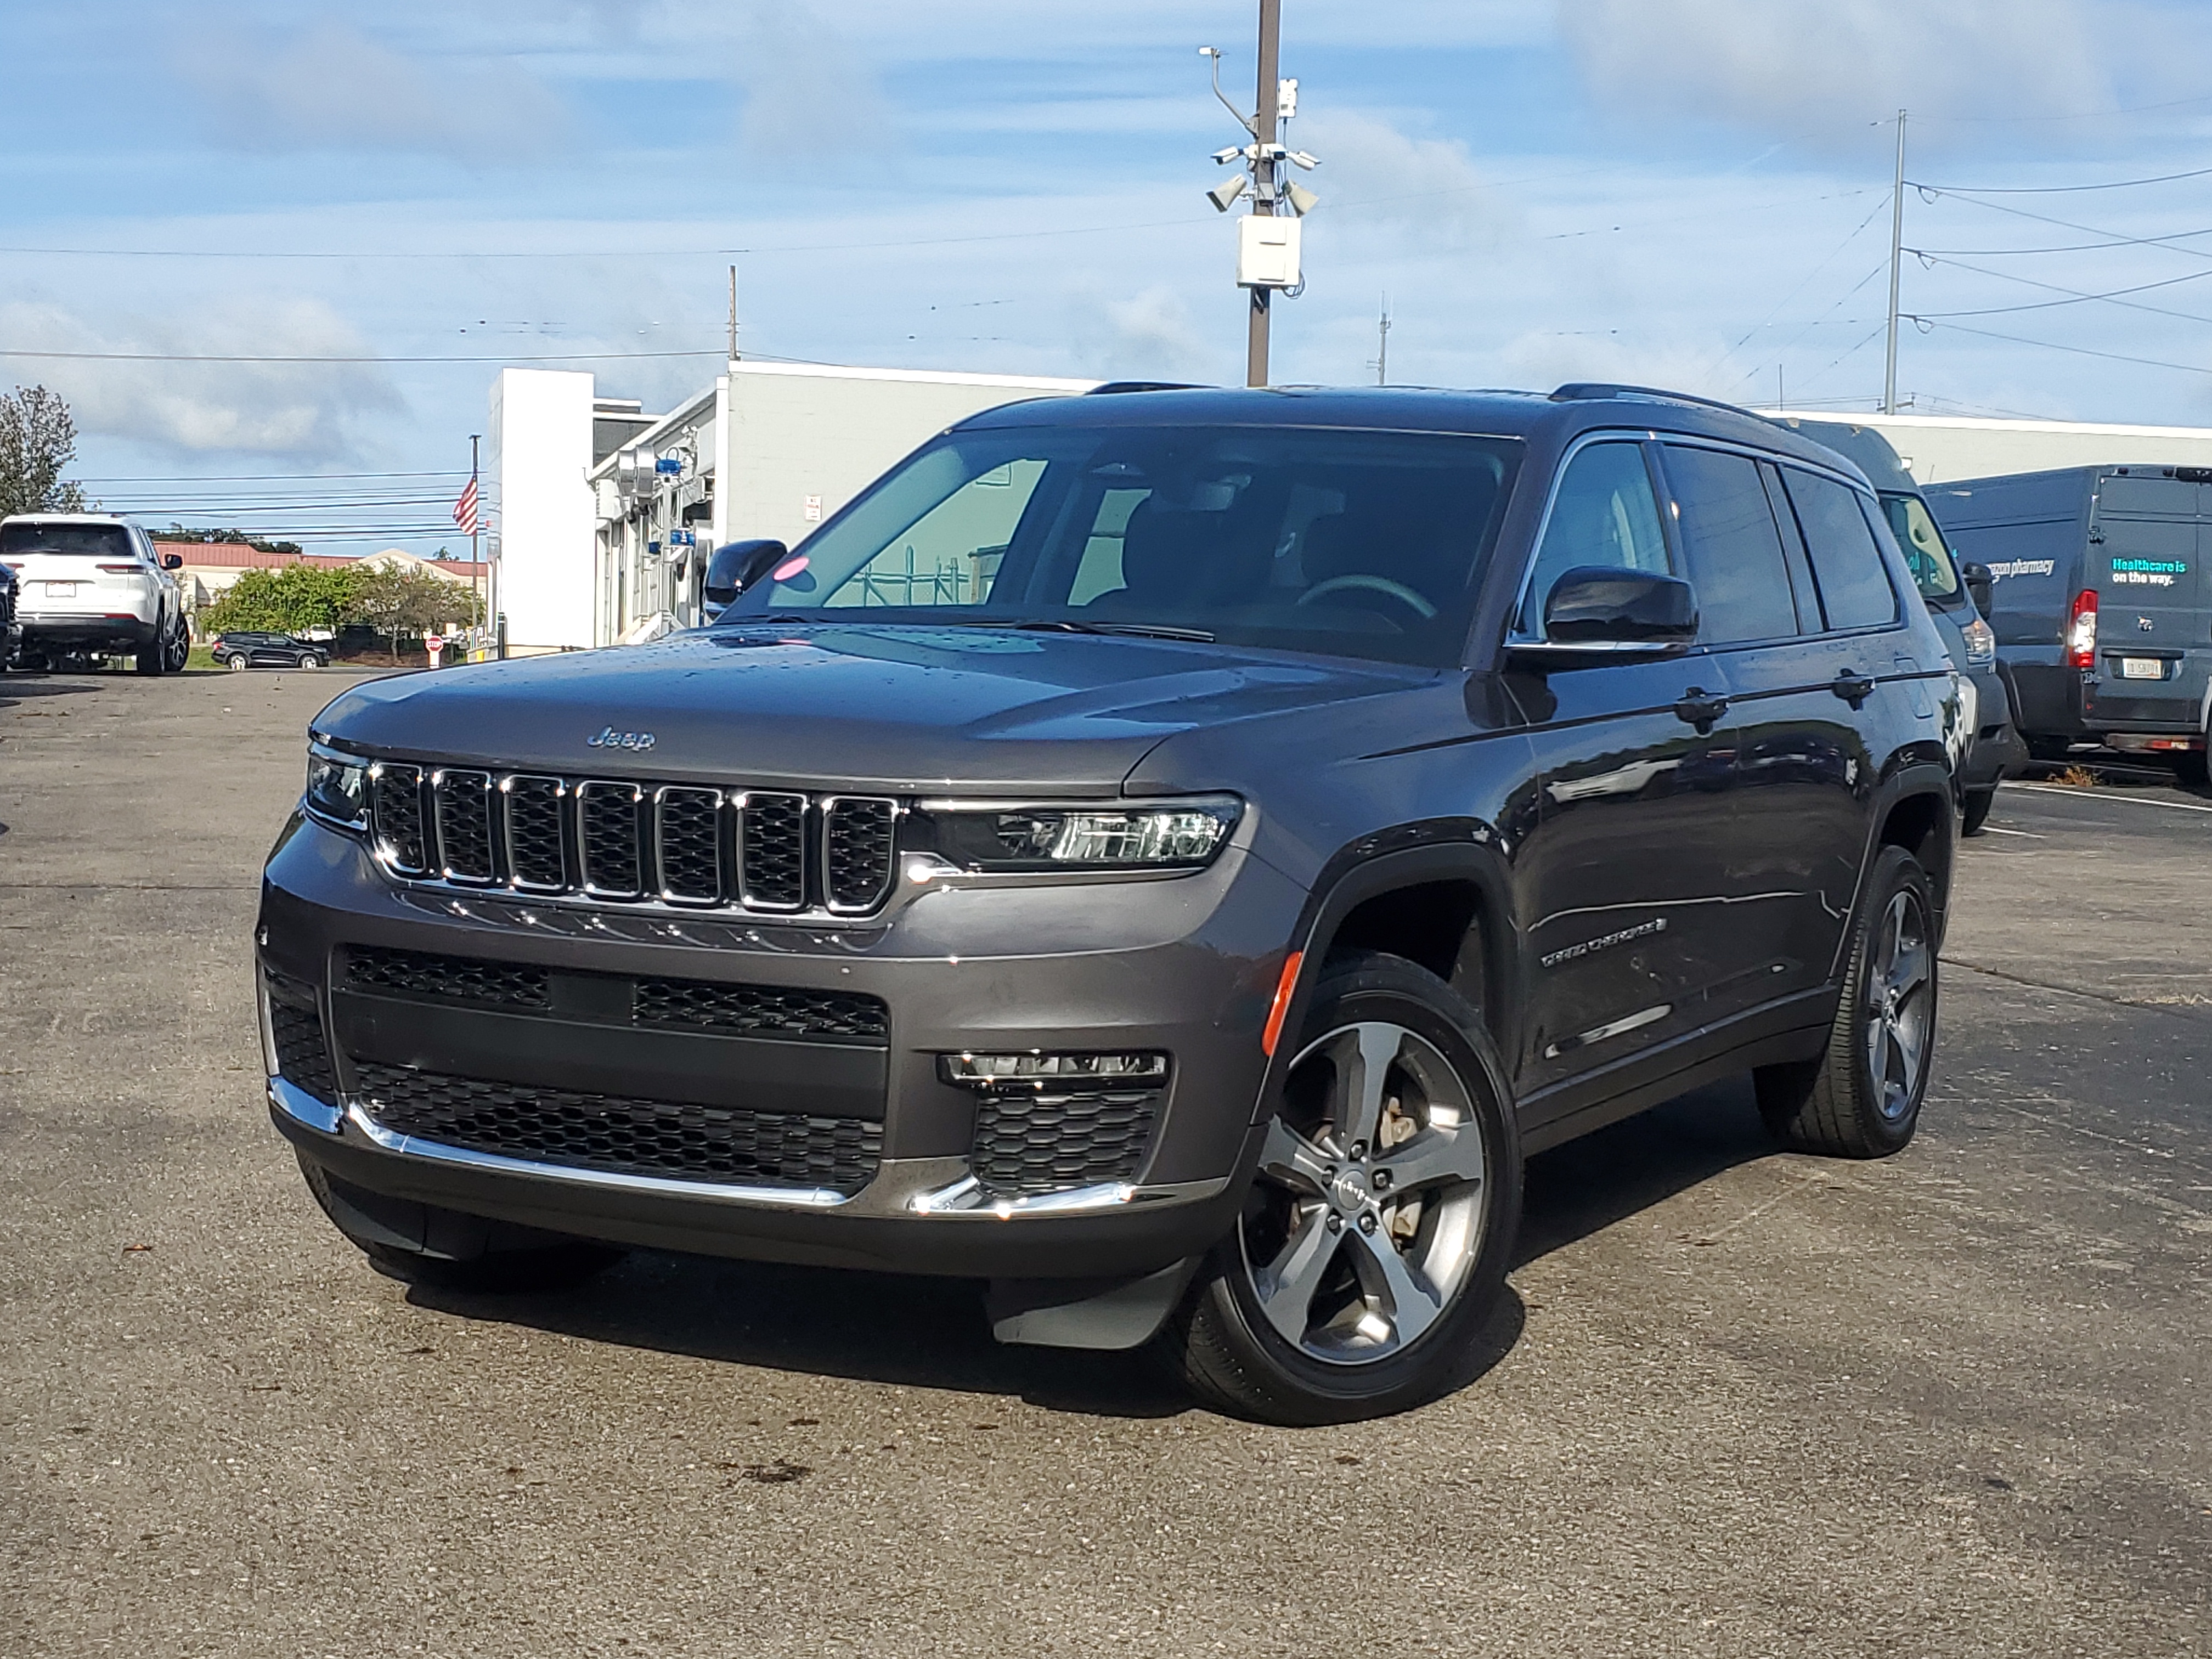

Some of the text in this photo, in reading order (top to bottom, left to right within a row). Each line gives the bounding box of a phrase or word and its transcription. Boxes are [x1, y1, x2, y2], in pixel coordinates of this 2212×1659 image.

[1985, 558, 2054, 578] azon pharmacy
[2113, 558, 2186, 572] Healthcare is
[2113, 572, 2174, 586] on the way.
[587, 726, 656, 751] Jeep
[1541, 943, 1587, 967] GRAND
[1588, 921, 1655, 950] CHEROKEE
